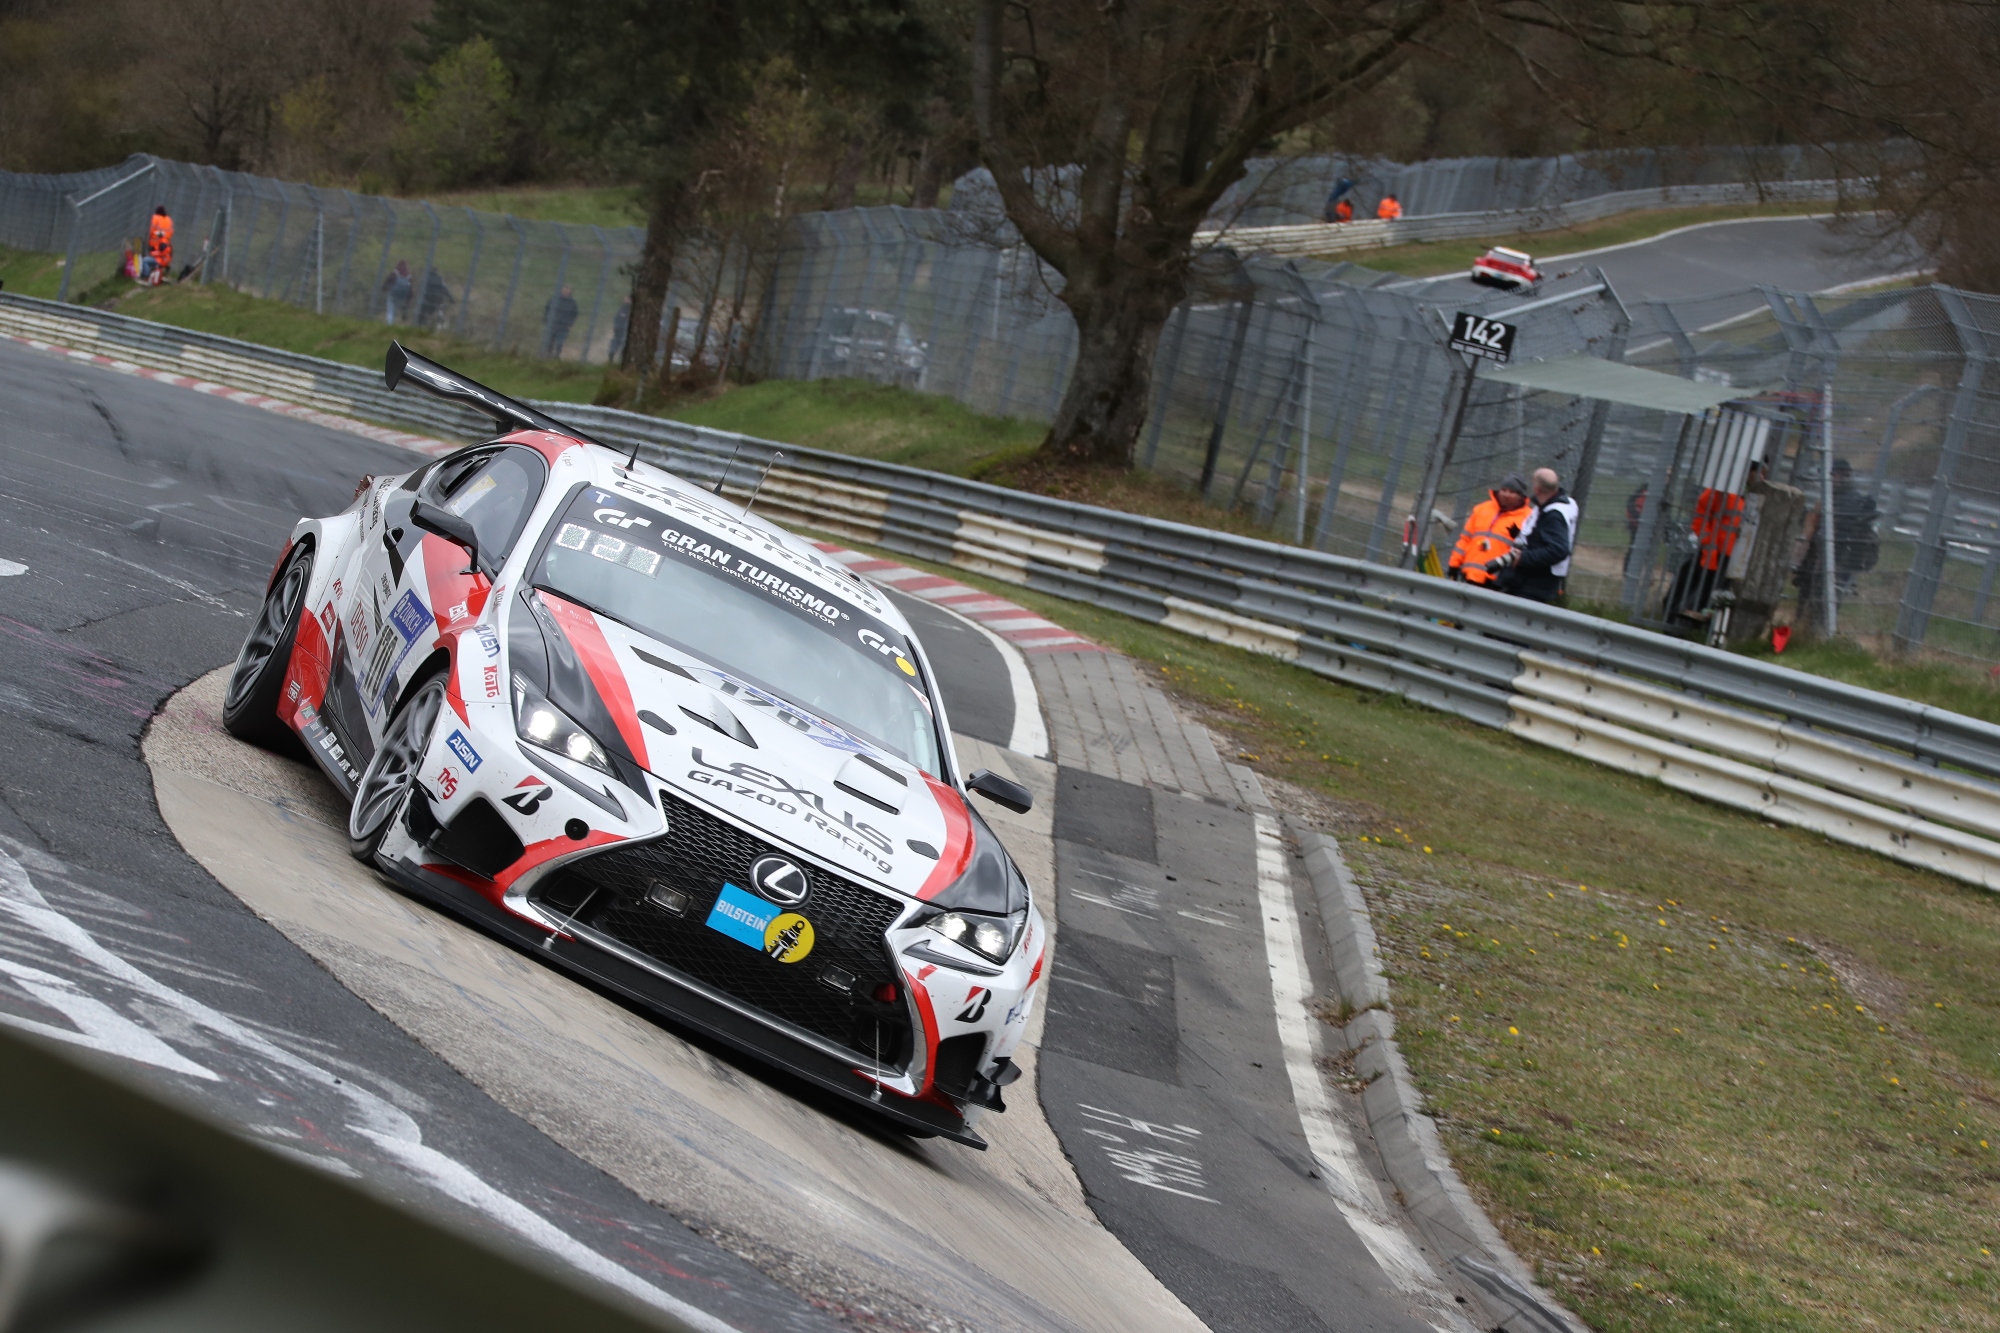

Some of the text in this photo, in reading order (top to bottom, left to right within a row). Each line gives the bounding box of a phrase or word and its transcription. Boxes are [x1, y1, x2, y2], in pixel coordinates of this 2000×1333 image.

[1463, 315, 1507, 349] 142
[595, 490, 612, 504] T
[614, 481, 754, 542] GAZOO
[555, 522, 661, 574] 027
[661, 528, 732, 564] GRAN
[662, 540, 836, 627] THE REAL DRIVING SIMULATOR
[763, 542, 882, 614] Racing
[350, 601, 370, 658] DENSO
[398, 602, 423, 635] ZURICH
[720, 679, 811, 733] 170
[449, 735, 479, 768] AISIN
[686, 769, 894, 875] GAZOO Racing
[691, 746, 895, 856] LEXUS
[716, 899, 768, 932] BILSTEIN
